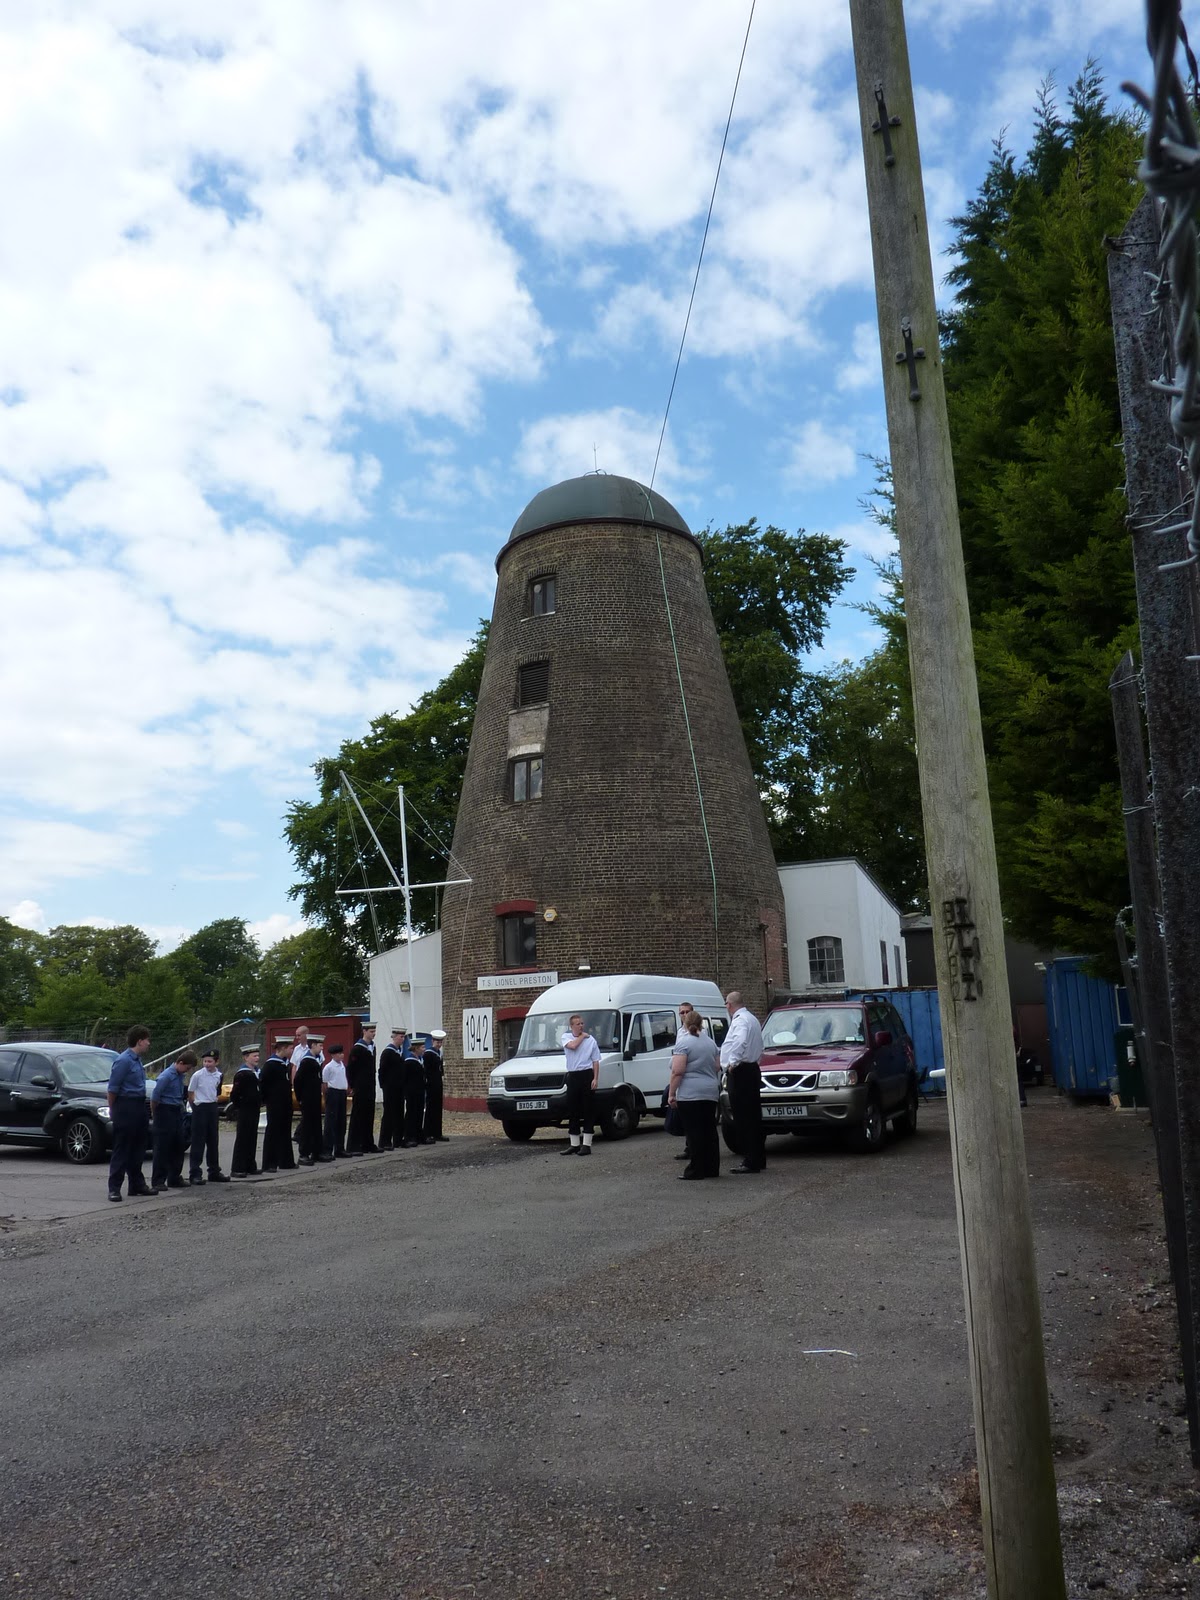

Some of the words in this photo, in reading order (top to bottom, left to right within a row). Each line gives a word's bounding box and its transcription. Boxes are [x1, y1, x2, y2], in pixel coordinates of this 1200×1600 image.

[494, 978, 517, 987] LIONEL
[519, 975, 552, 985] PRESTON
[465, 1014, 489, 1052] 1942
[766, 1107, 785, 1116] YJ51
[786, 1106, 803, 1115] GXH
